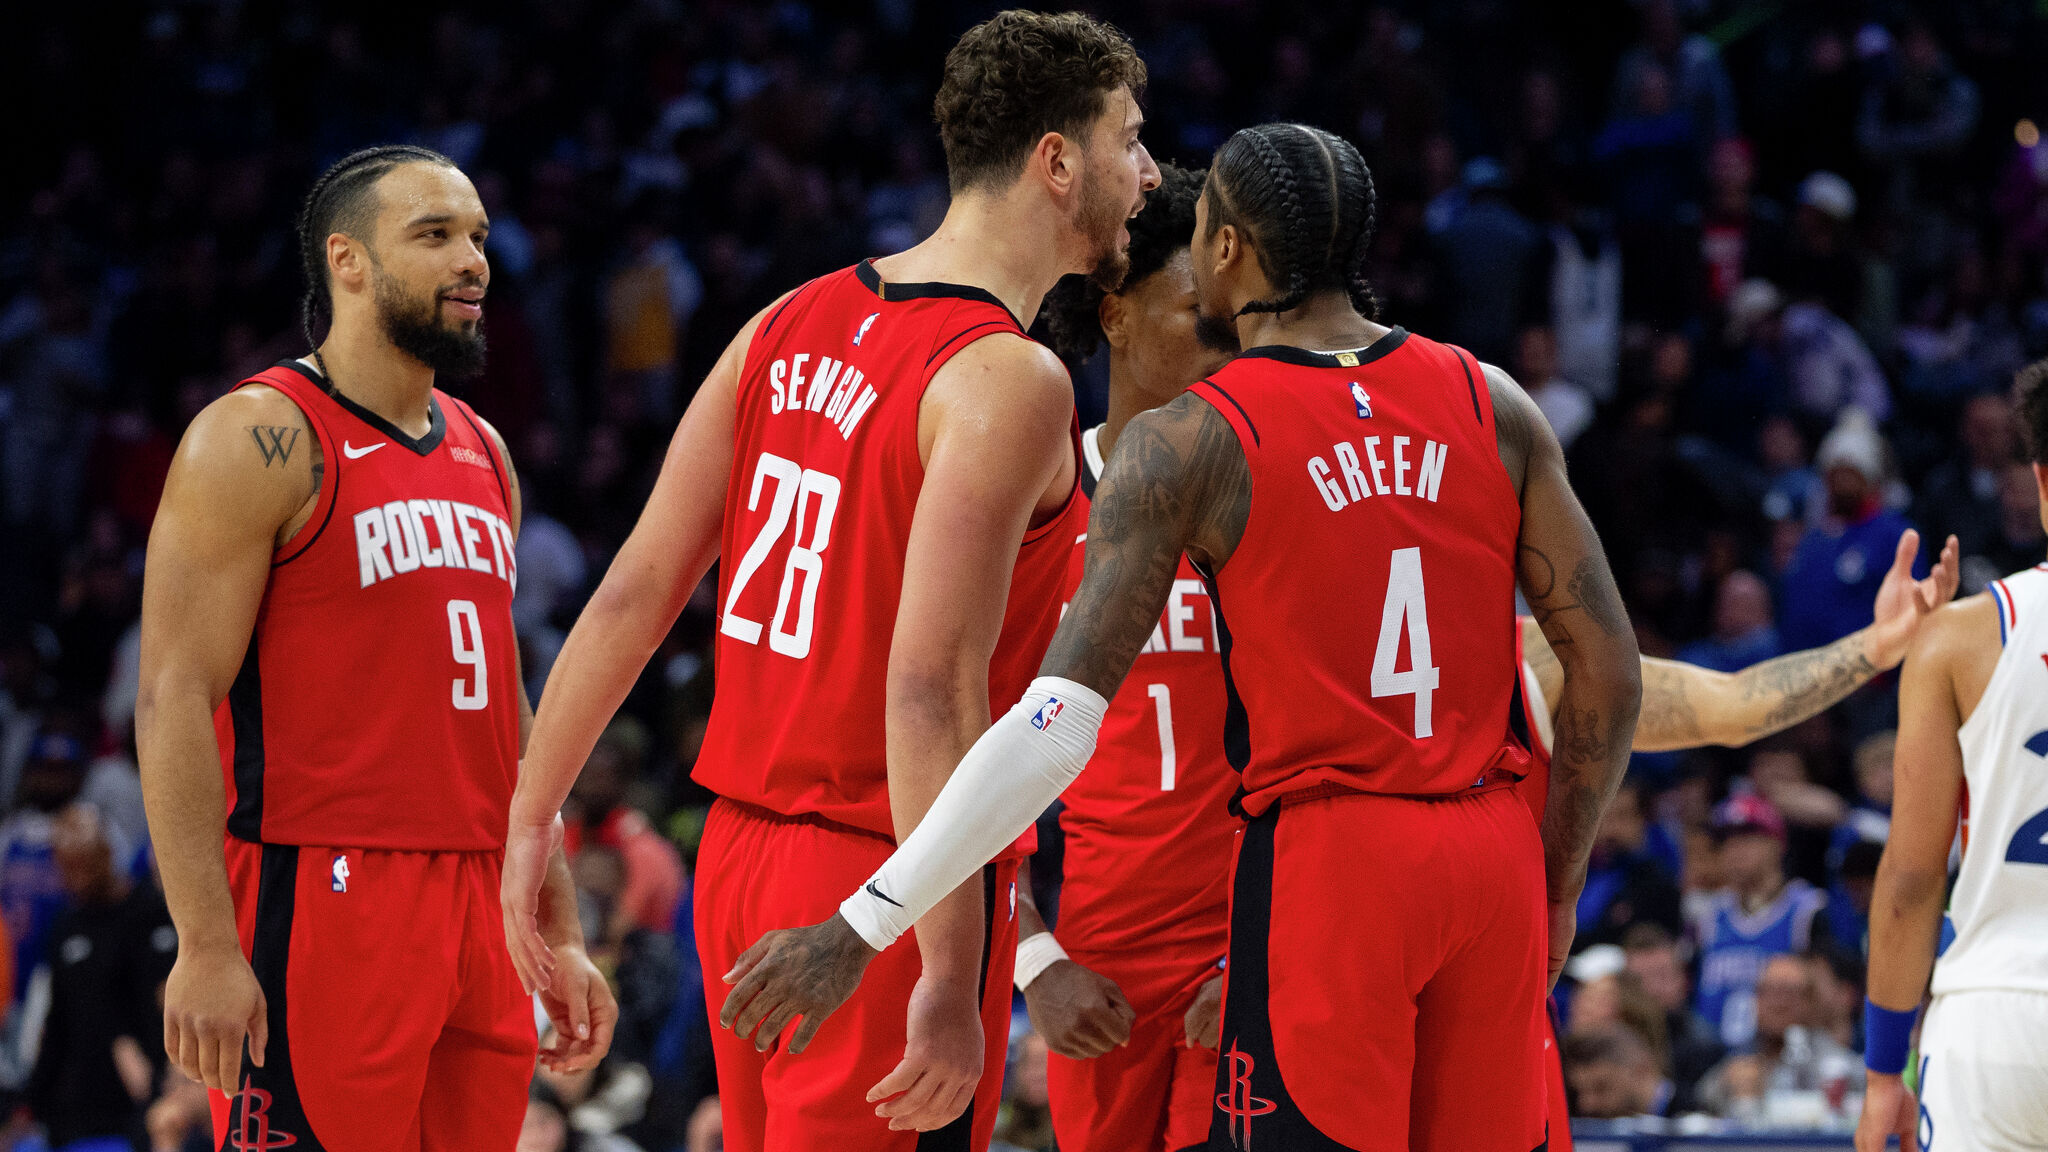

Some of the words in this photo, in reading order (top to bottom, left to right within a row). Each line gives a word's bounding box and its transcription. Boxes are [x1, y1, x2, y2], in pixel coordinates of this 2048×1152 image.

[770, 353, 878, 441] SENGUN
[1307, 435, 1448, 512] GREEN
[720, 451, 841, 659] 28
[447, 599, 488, 710] 9
[1370, 546, 1440, 739] 4
[1148, 683, 1176, 791] 1
